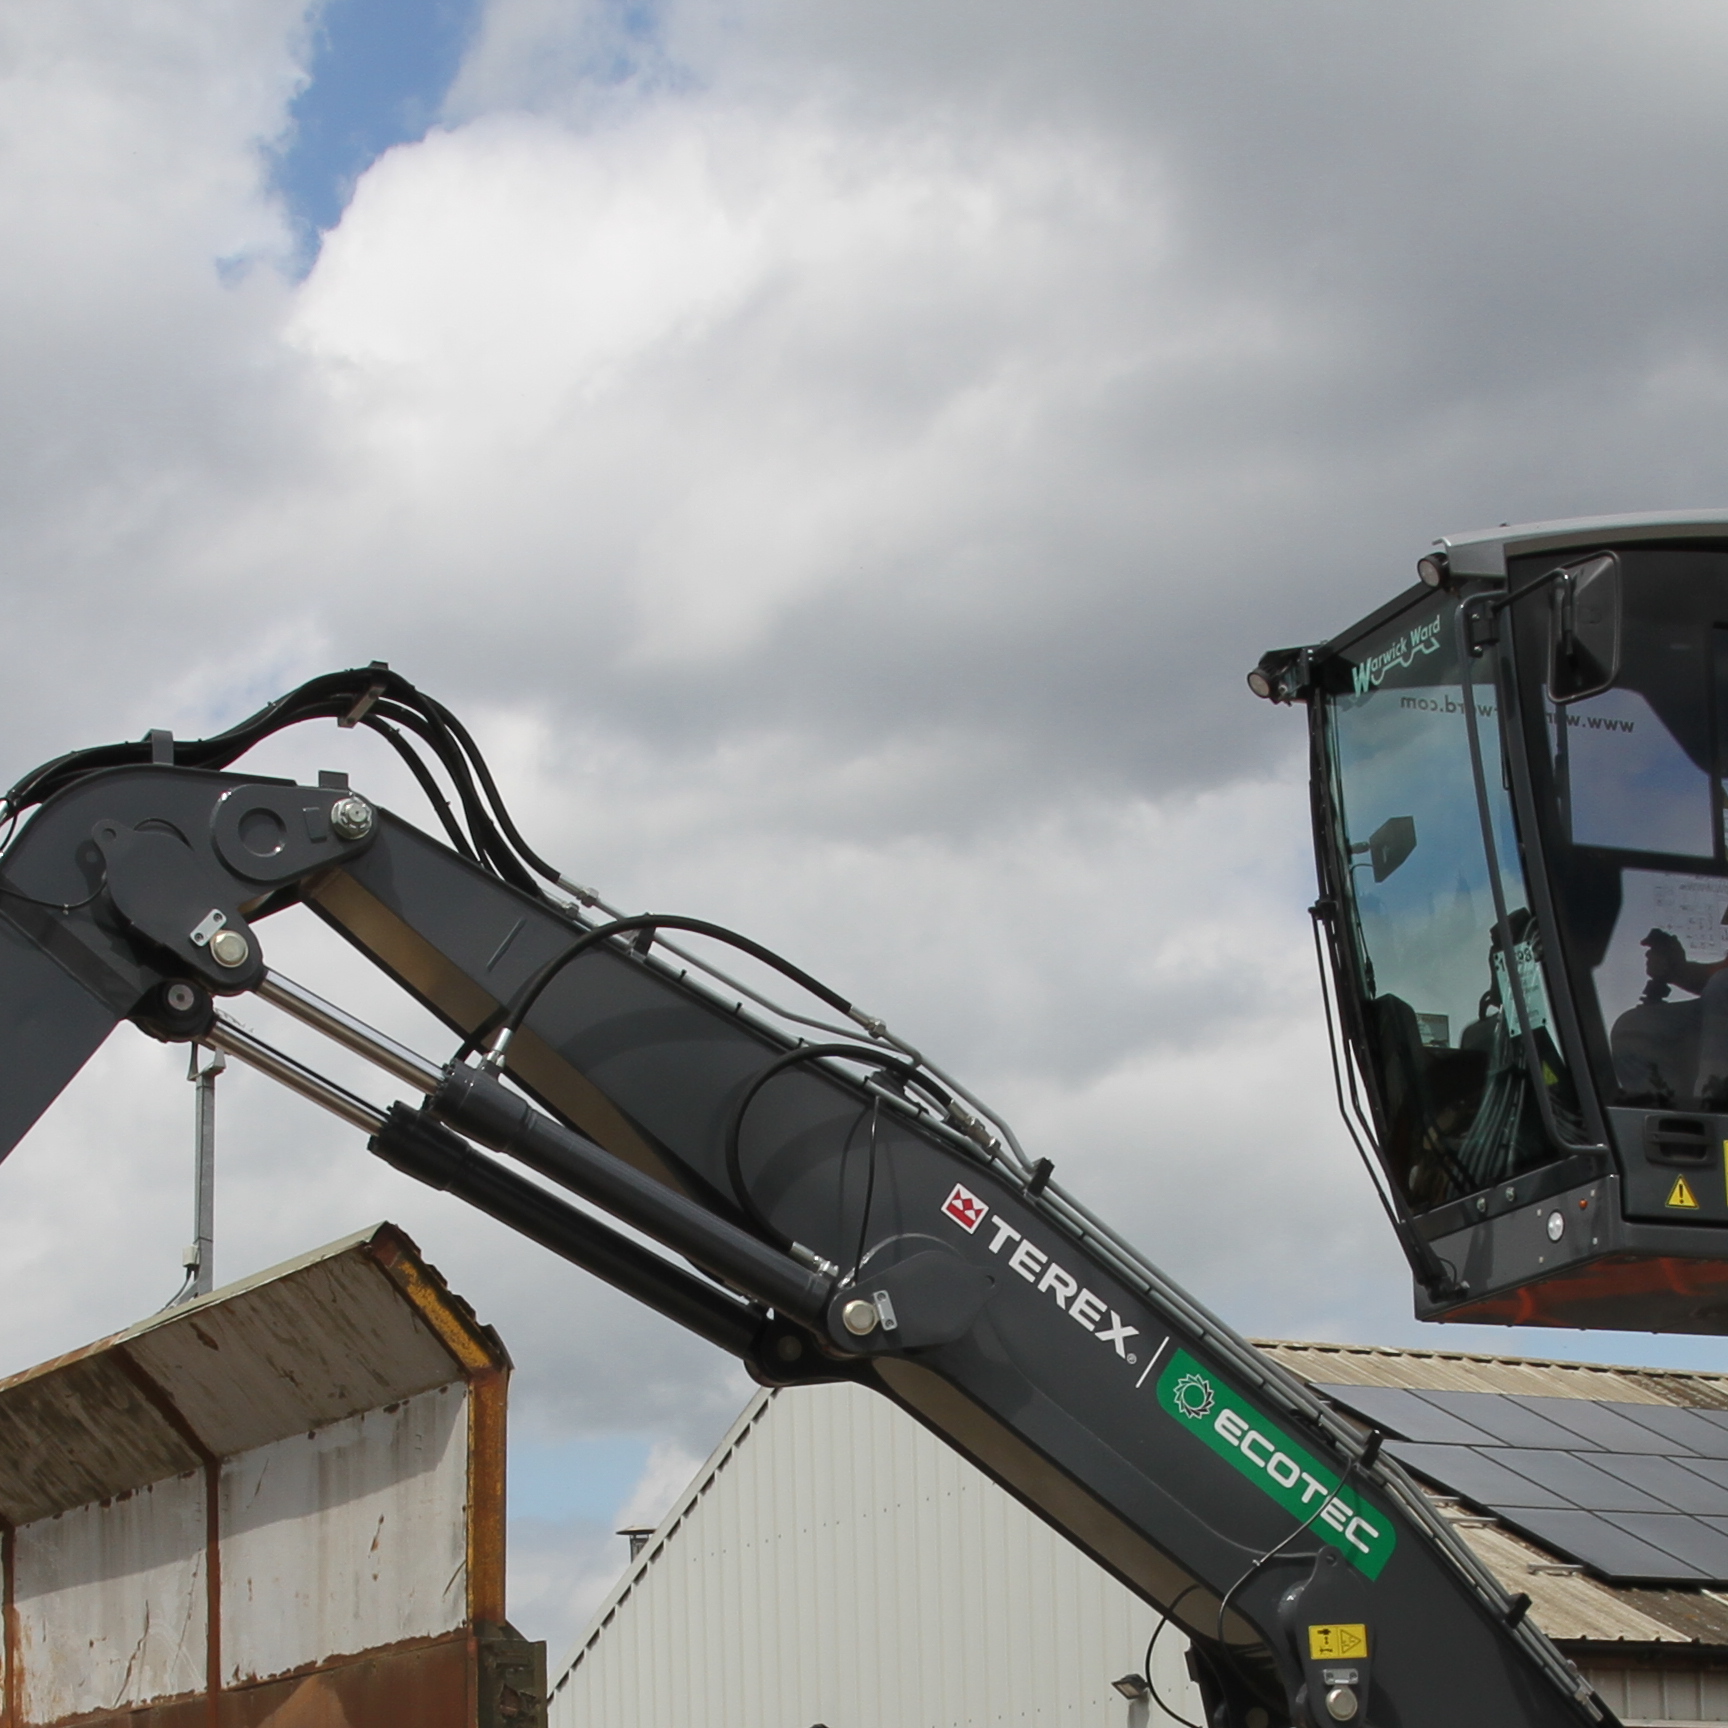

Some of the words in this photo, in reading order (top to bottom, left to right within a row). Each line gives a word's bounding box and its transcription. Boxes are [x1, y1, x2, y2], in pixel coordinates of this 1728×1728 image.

[1351, 635, 1408, 698] Warwick
[1409, 614, 1441, 647] Ward
[988, 1214, 1140, 1360] TEREX
[1214, 1408, 1380, 1554] ECOTEC
